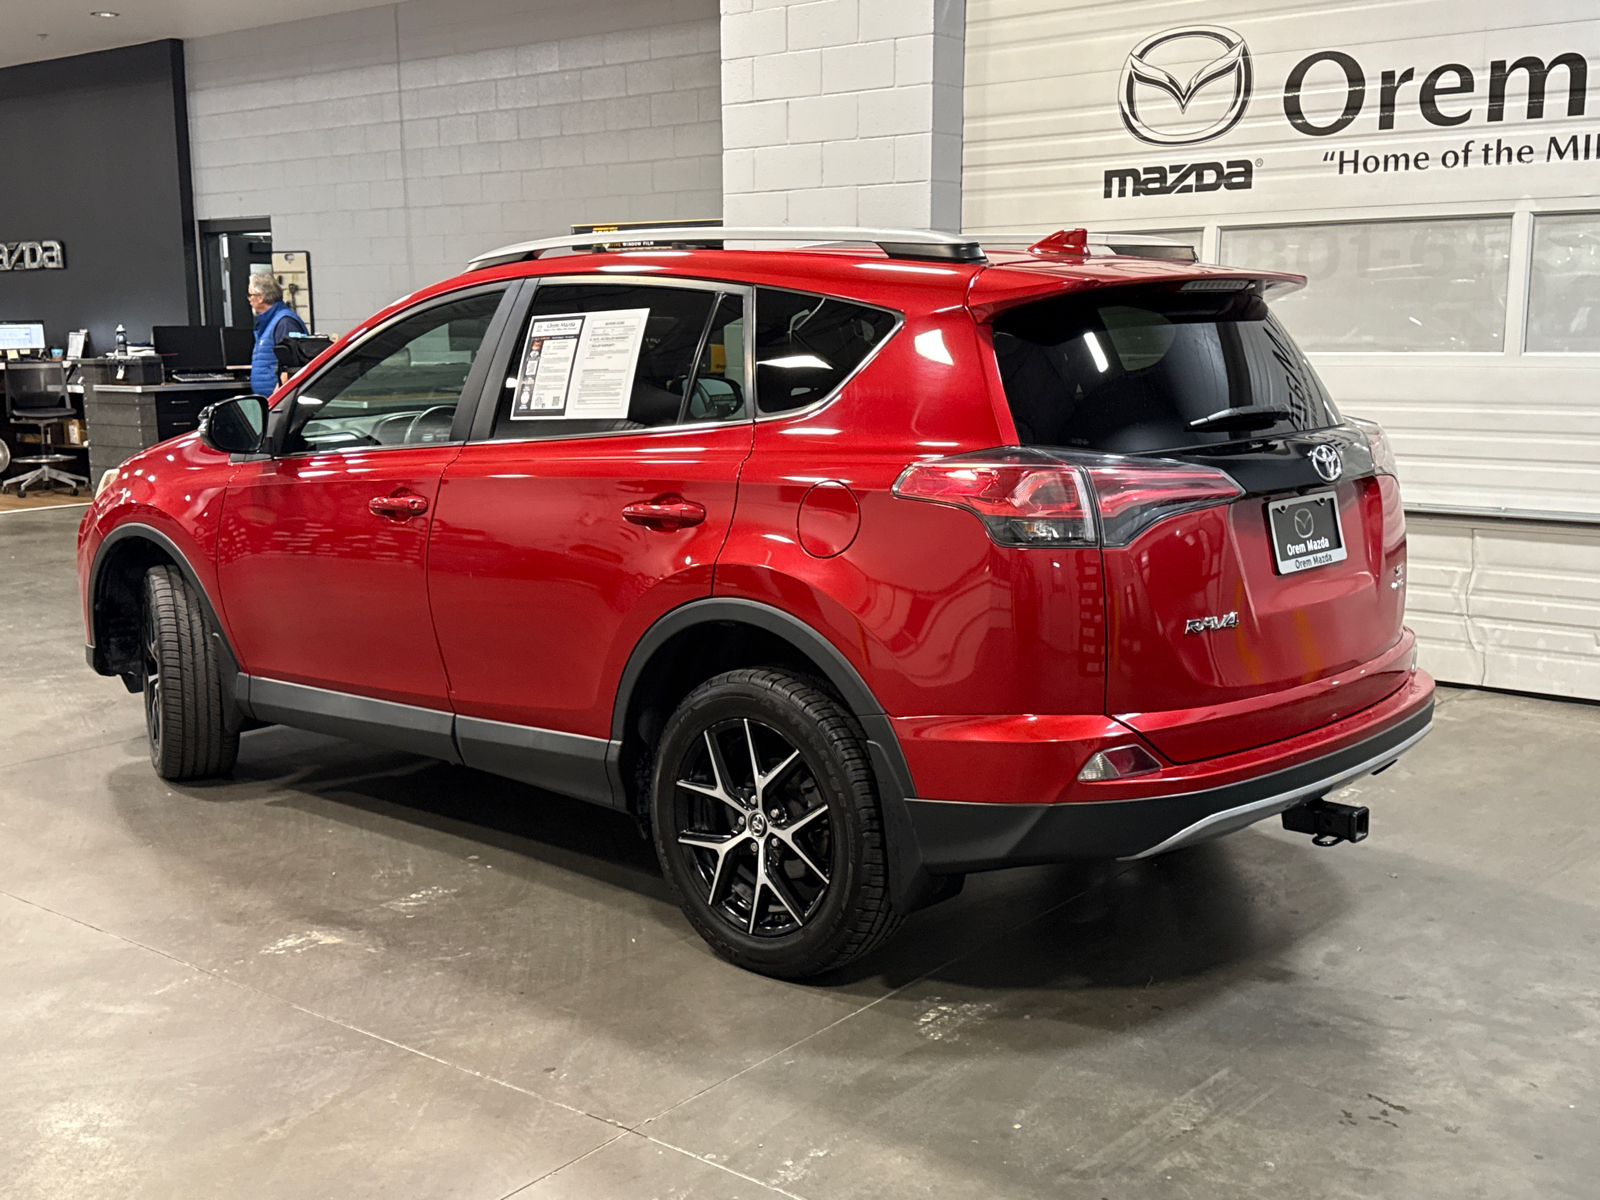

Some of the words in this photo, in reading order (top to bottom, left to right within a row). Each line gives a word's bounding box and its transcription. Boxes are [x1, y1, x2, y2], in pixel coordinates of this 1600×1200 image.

[1283, 50, 1588, 137] Orem
[1441, 140, 1475, 168] of
[1481, 139, 1535, 166] the
[1286, 543, 1306, 556] Orem
[1306, 536, 1330, 551] Mazda
[1295, 559, 1312, 569] Orem
[1312, 553, 1333, 566] Mazda
[1184, 611, 1239, 635] RAV4
